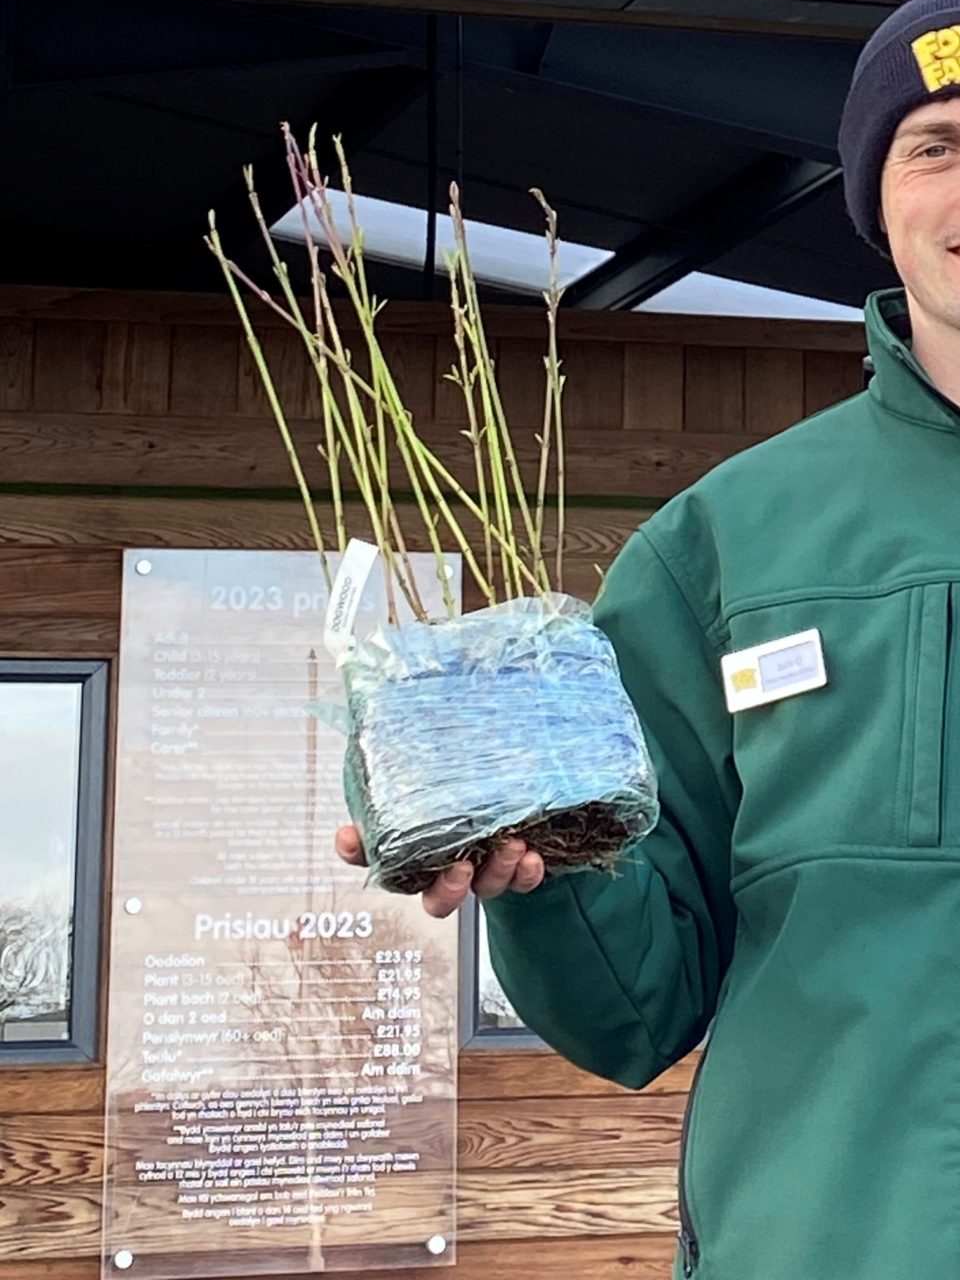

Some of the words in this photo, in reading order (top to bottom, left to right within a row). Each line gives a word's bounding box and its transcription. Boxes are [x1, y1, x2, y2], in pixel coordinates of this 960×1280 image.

[210, 586, 283, 612] 2023
[197, 687, 206, 700] 2
[194, 911, 290, 941] Prisiau
[299, 911, 373, 939] 2023
[144, 954, 205, 968] Oedolion
[375, 950, 422, 964] £23.95
[144, 973, 179, 987] Plant
[143, 992, 178, 1006] Plant
[181, 991, 214, 1006] bach
[143, 1012, 155, 1025] O
[158, 1011, 184, 1025] dan
[188, 1011, 197, 1024] 2
[201, 1009, 227, 1024] oed
[362, 1006, 385, 1020] Am
[361, 1063, 385, 1077] Am
